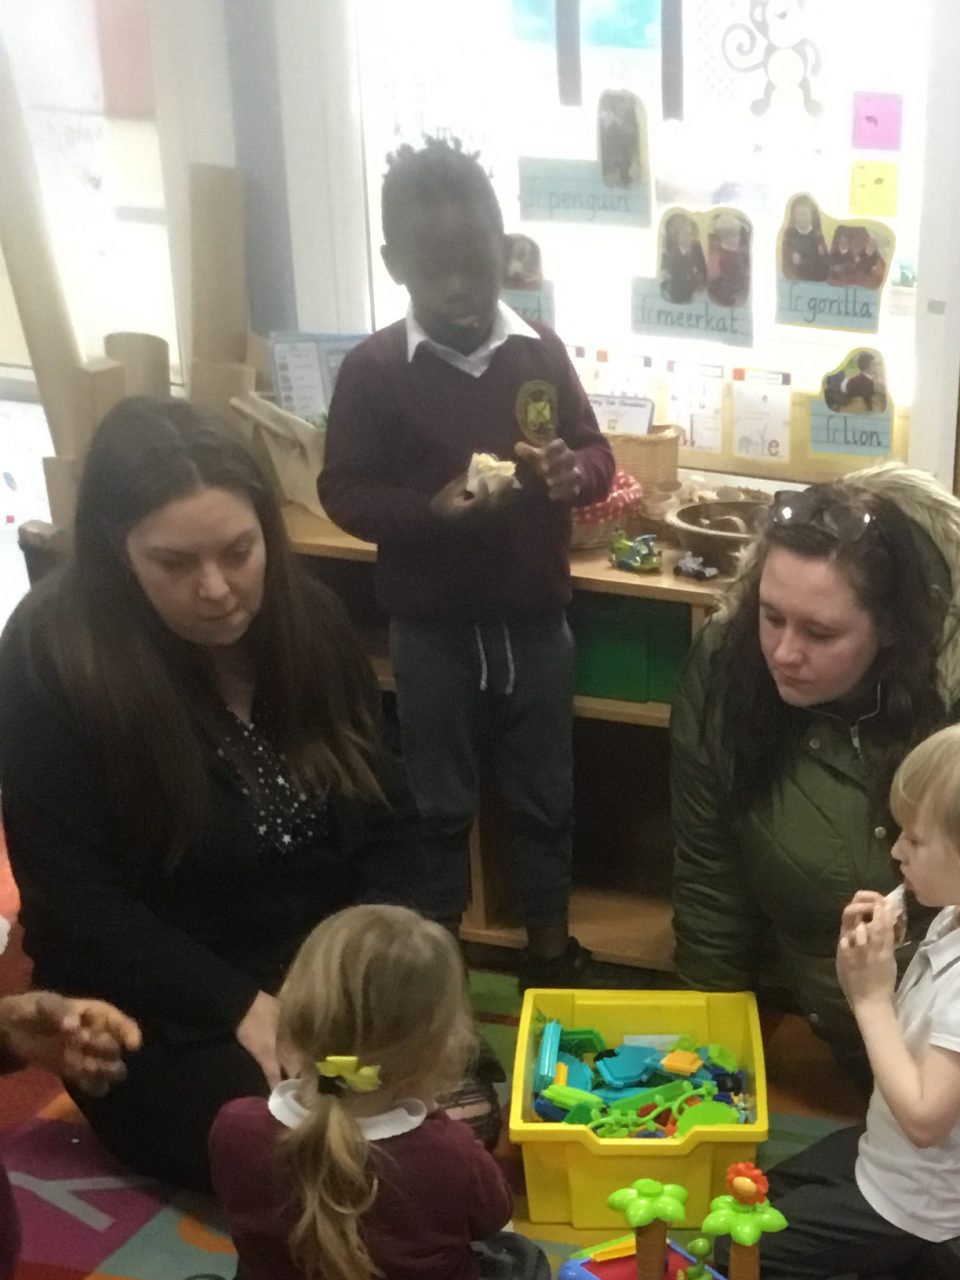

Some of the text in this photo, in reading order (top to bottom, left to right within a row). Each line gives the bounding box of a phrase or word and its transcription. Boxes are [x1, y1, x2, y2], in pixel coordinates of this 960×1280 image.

[657, 300, 740, 335] meerkat
[805, 286, 873, 325] gorilla
[844, 415, 882, 447] lion
